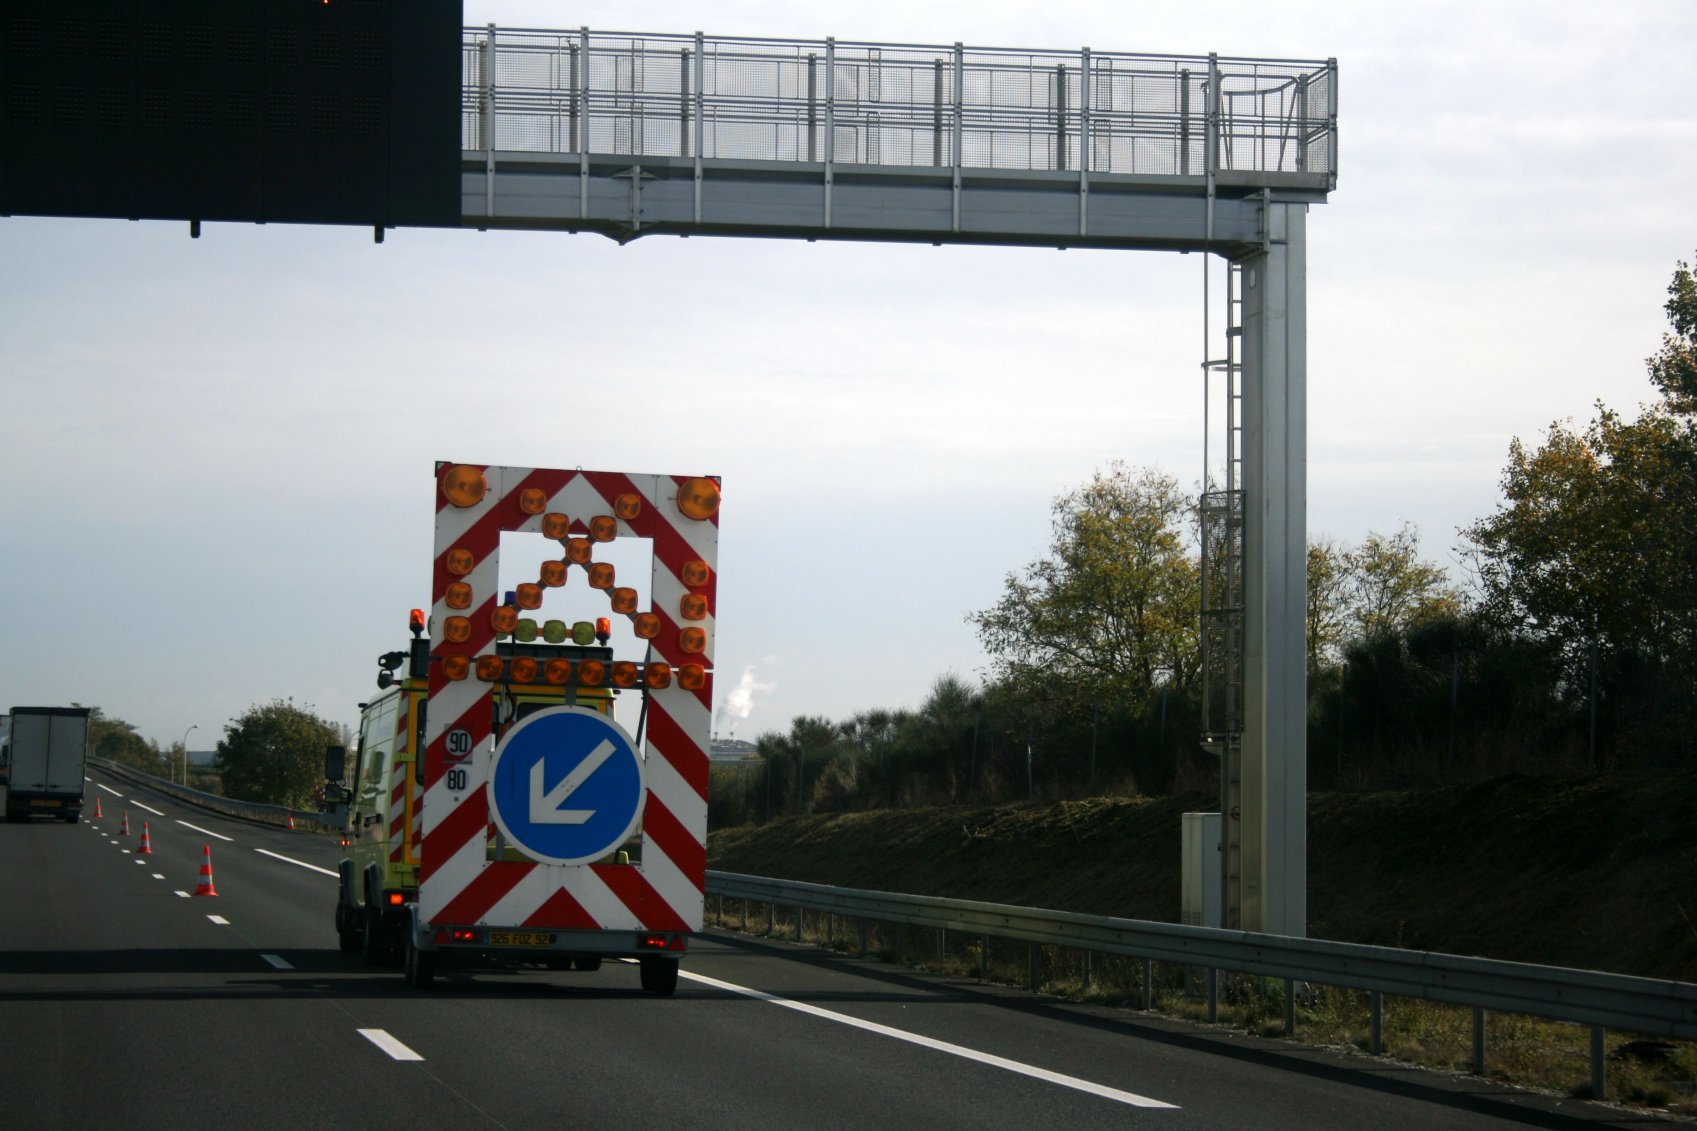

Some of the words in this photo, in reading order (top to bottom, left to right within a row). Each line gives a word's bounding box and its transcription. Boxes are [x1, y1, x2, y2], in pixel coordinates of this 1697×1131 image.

[450, 732, 468, 753] 90
[447, 769, 467, 790] 80
[535, 934, 548, 945] 92
